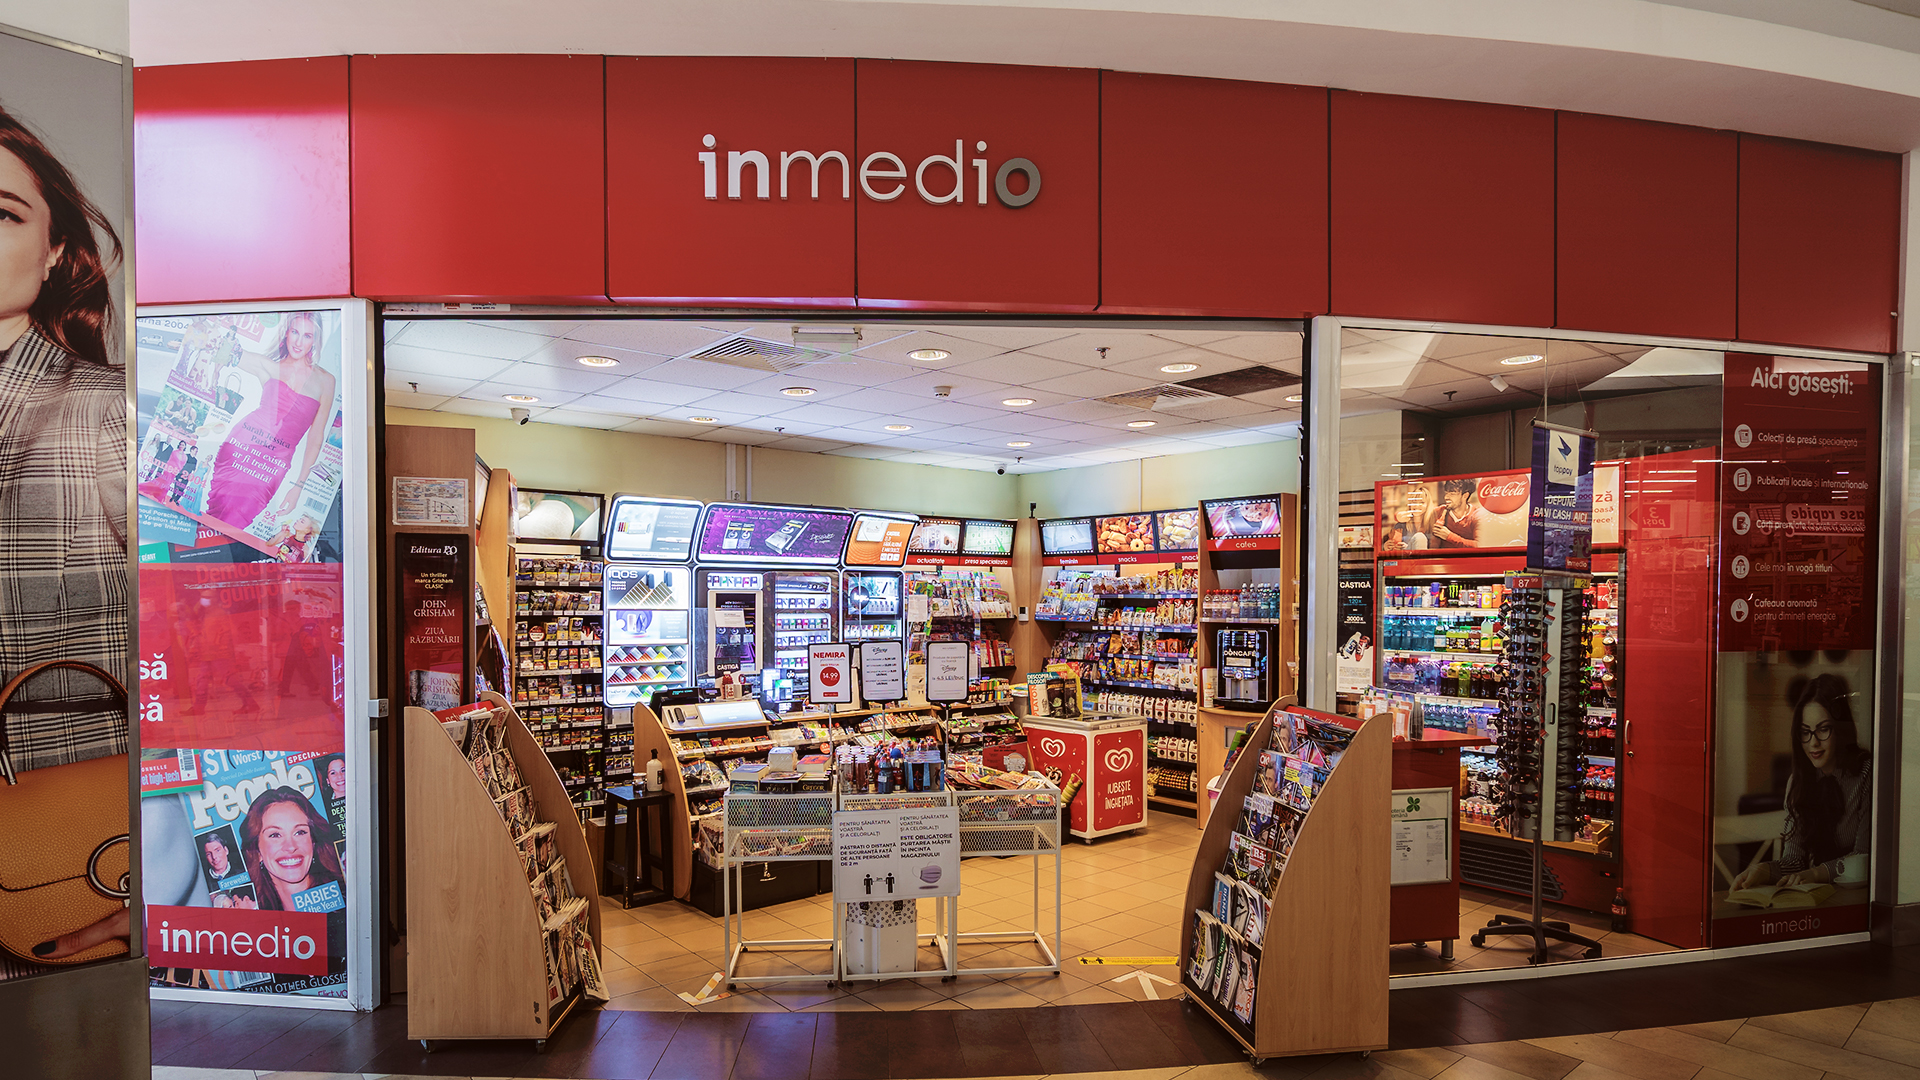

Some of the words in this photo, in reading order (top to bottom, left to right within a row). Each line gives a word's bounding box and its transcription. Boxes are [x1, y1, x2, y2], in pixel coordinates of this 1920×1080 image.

[699, 133, 1041, 208] inmedio
[1751, 366, 1783, 390] Aici
[242, 422, 265, 436] Sarah
[265, 431, 291, 449] Jessica
[1785, 434, 1796, 443] de
[1796, 436, 1817, 445] presă
[229, 437, 249, 451] Dacă
[250, 448, 262, 457] nu
[250, 435, 276, 452] Parker
[140, 450, 180, 475] Cannes
[232, 451, 244, 460] ar
[242, 454, 251, 464] fi
[251, 459, 279, 476] trebuit
[181, 470, 207, 489] 2004
[1791, 478, 1813, 487] locale
[1547, 495, 1577, 508] DEPUNE
[143, 514, 168, 525] Ypsilon
[176, 519, 191, 528] Mini
[152, 510, 178, 520] Porsche
[263, 510, 276, 523] 24
[1534, 507, 1551, 518] BANI
[1552, 509, 1572, 520] CASH
[1573, 511, 1588, 524] AICI
[165, 523, 191, 533] Internet
[410, 545, 442, 554] Editura
[1235, 541, 1257, 549] cafea
[1755, 562, 1771, 572] Cele
[1772, 563, 1786, 572] mai
[1796, 563, 1814, 574] vogă
[1815, 563, 1833, 573] titluri
[608, 570, 638, 580] IQOS
[1518, 579, 1530, 589] 87
[422, 600, 447, 609] JOHN
[1754, 598, 1786, 608] Cafeaua
[413, 609, 455, 617] GRISHAM
[1754, 612, 1777, 622] pentru
[1807, 612, 1837, 623] energice
[425, 627, 445, 635] ZIUA
[410, 634, 460, 644] RĂZBUNĂRII
[813, 651, 846, 659] NEMIRA
[430, 677, 452, 687] JOHN
[421, 684, 459, 695] GRISHAM
[288, 750, 321, 765] SPECIAL
[149, 770, 180, 786] high-tech
[1107, 779, 1131, 795] IUBEȘTE
[187, 759, 316, 831] People
[915, 833, 953, 841] OBLIGATORIE
[219, 873, 249, 889] Farewells
[294, 884, 340, 908] BABIES
[320, 897, 343, 912] Year!
[1761, 915, 1821, 935] inmedio
[160, 920, 316, 960] inmedio
[274, 979, 307, 994] OTHER
